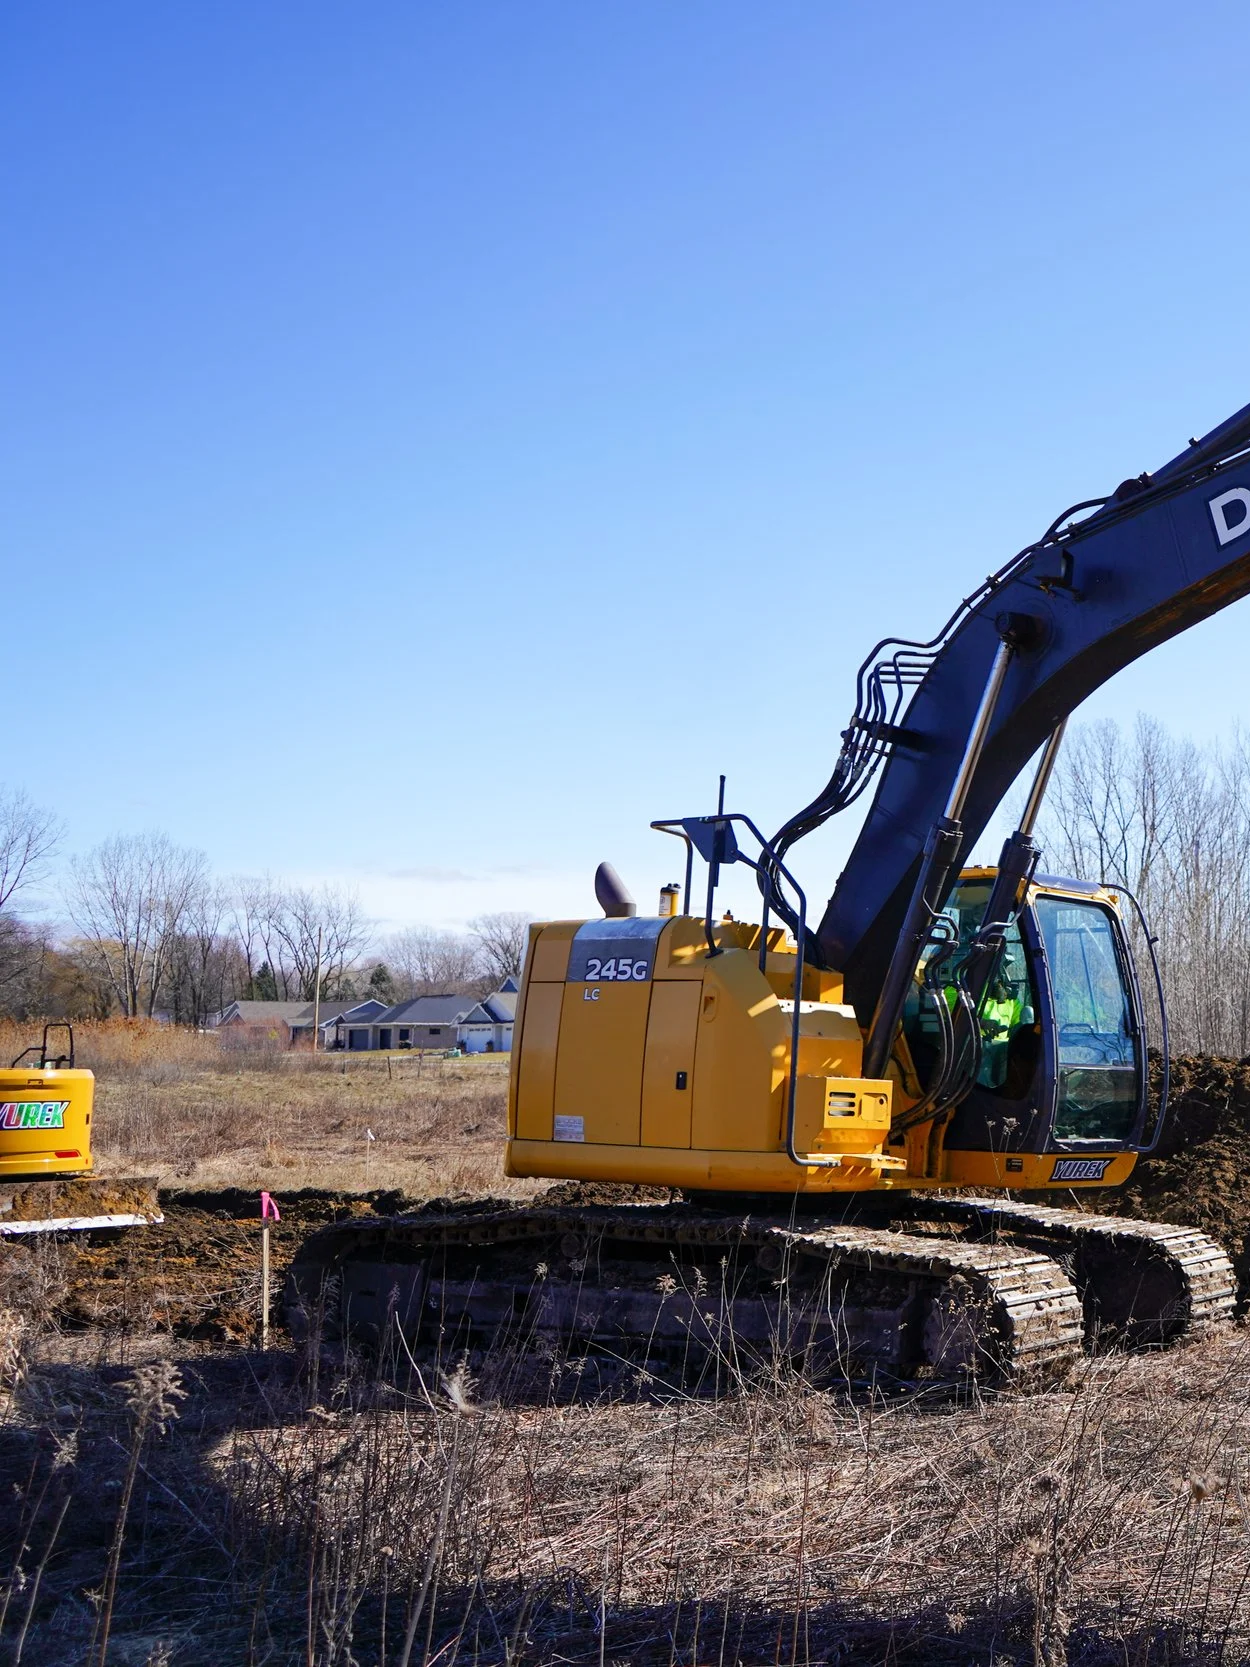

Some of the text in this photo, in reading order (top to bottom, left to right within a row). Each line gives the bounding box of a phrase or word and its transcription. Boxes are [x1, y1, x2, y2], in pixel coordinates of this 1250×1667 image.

[585, 958, 648, 980] 245G
[583, 988, 600, 1000] LC
[1052, 1160, 1110, 1179] YUREK
